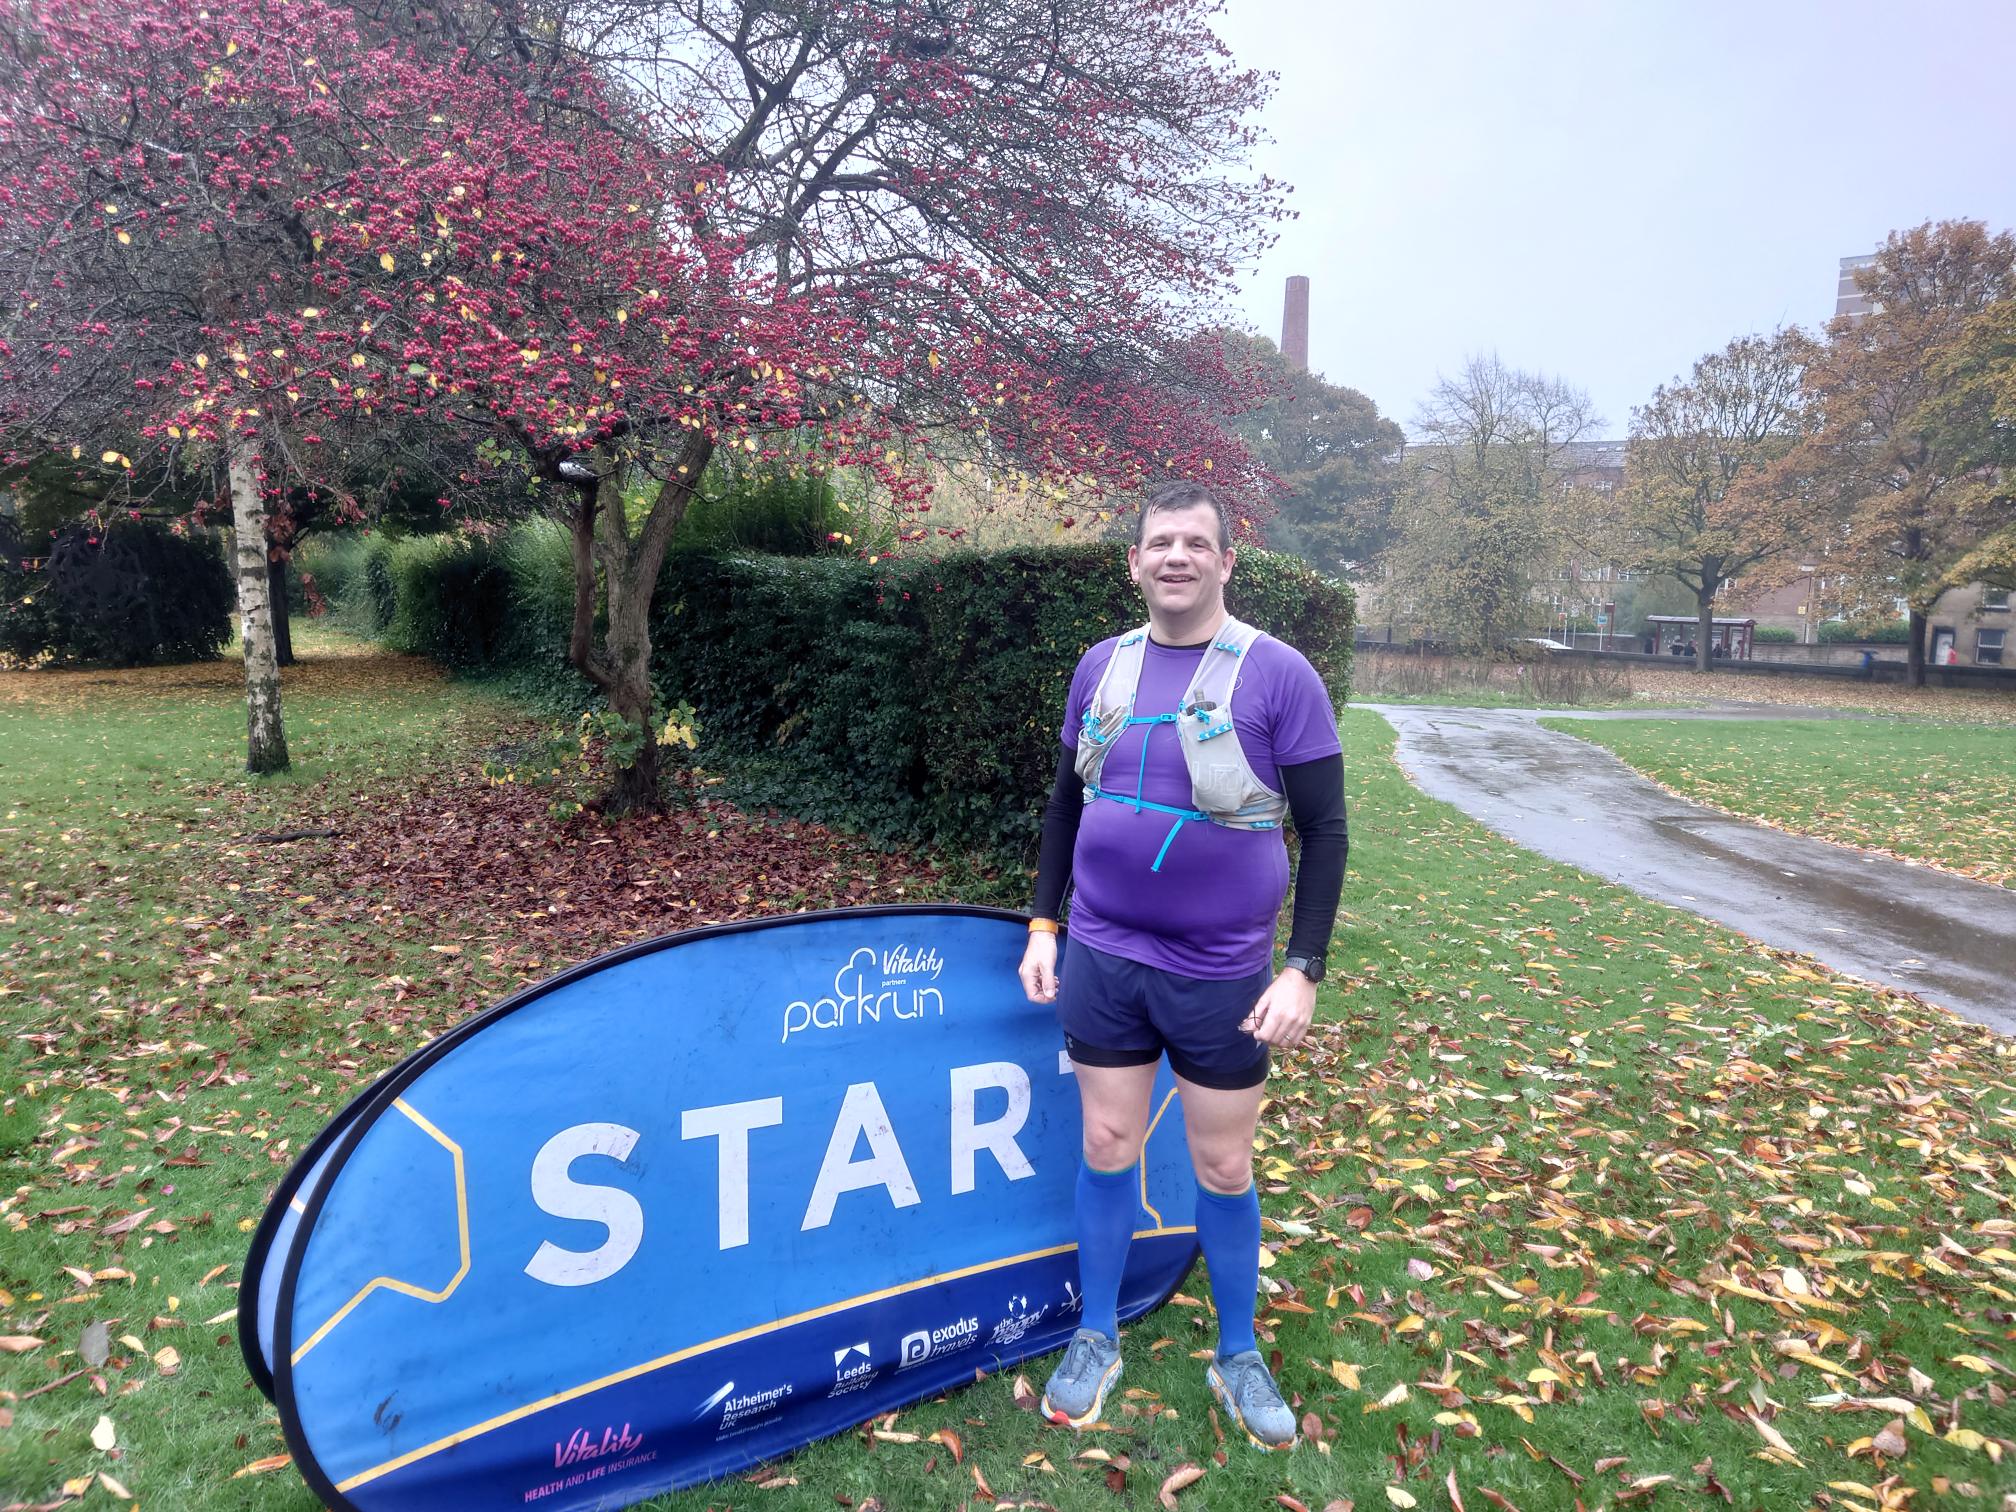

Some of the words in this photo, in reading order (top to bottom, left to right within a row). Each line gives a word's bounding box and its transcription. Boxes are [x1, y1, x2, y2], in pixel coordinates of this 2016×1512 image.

[883, 944, 944, 981] Vitality
[881, 978, 907, 988] partners
[781, 973, 944, 1044] parkrun
[523, 1050, 1076, 1287] STAR
[932, 1315, 979, 1344] exodus
[930, 1332, 978, 1358] travels
[833, 1370, 879, 1391] Building
[836, 1361, 872, 1382] Leeds
[722, 1400, 777, 1423] Research
[724, 1383, 793, 1414] Alzheimer's
[719, 1420, 737, 1431] UK
[554, 1422, 644, 1469] Vitality
[524, 1479, 564, 1503] HEALTH
[565, 1473, 585, 1488] AND
[586, 1466, 606, 1482] LIFE
[608, 1450, 657, 1475] INSURANCE
